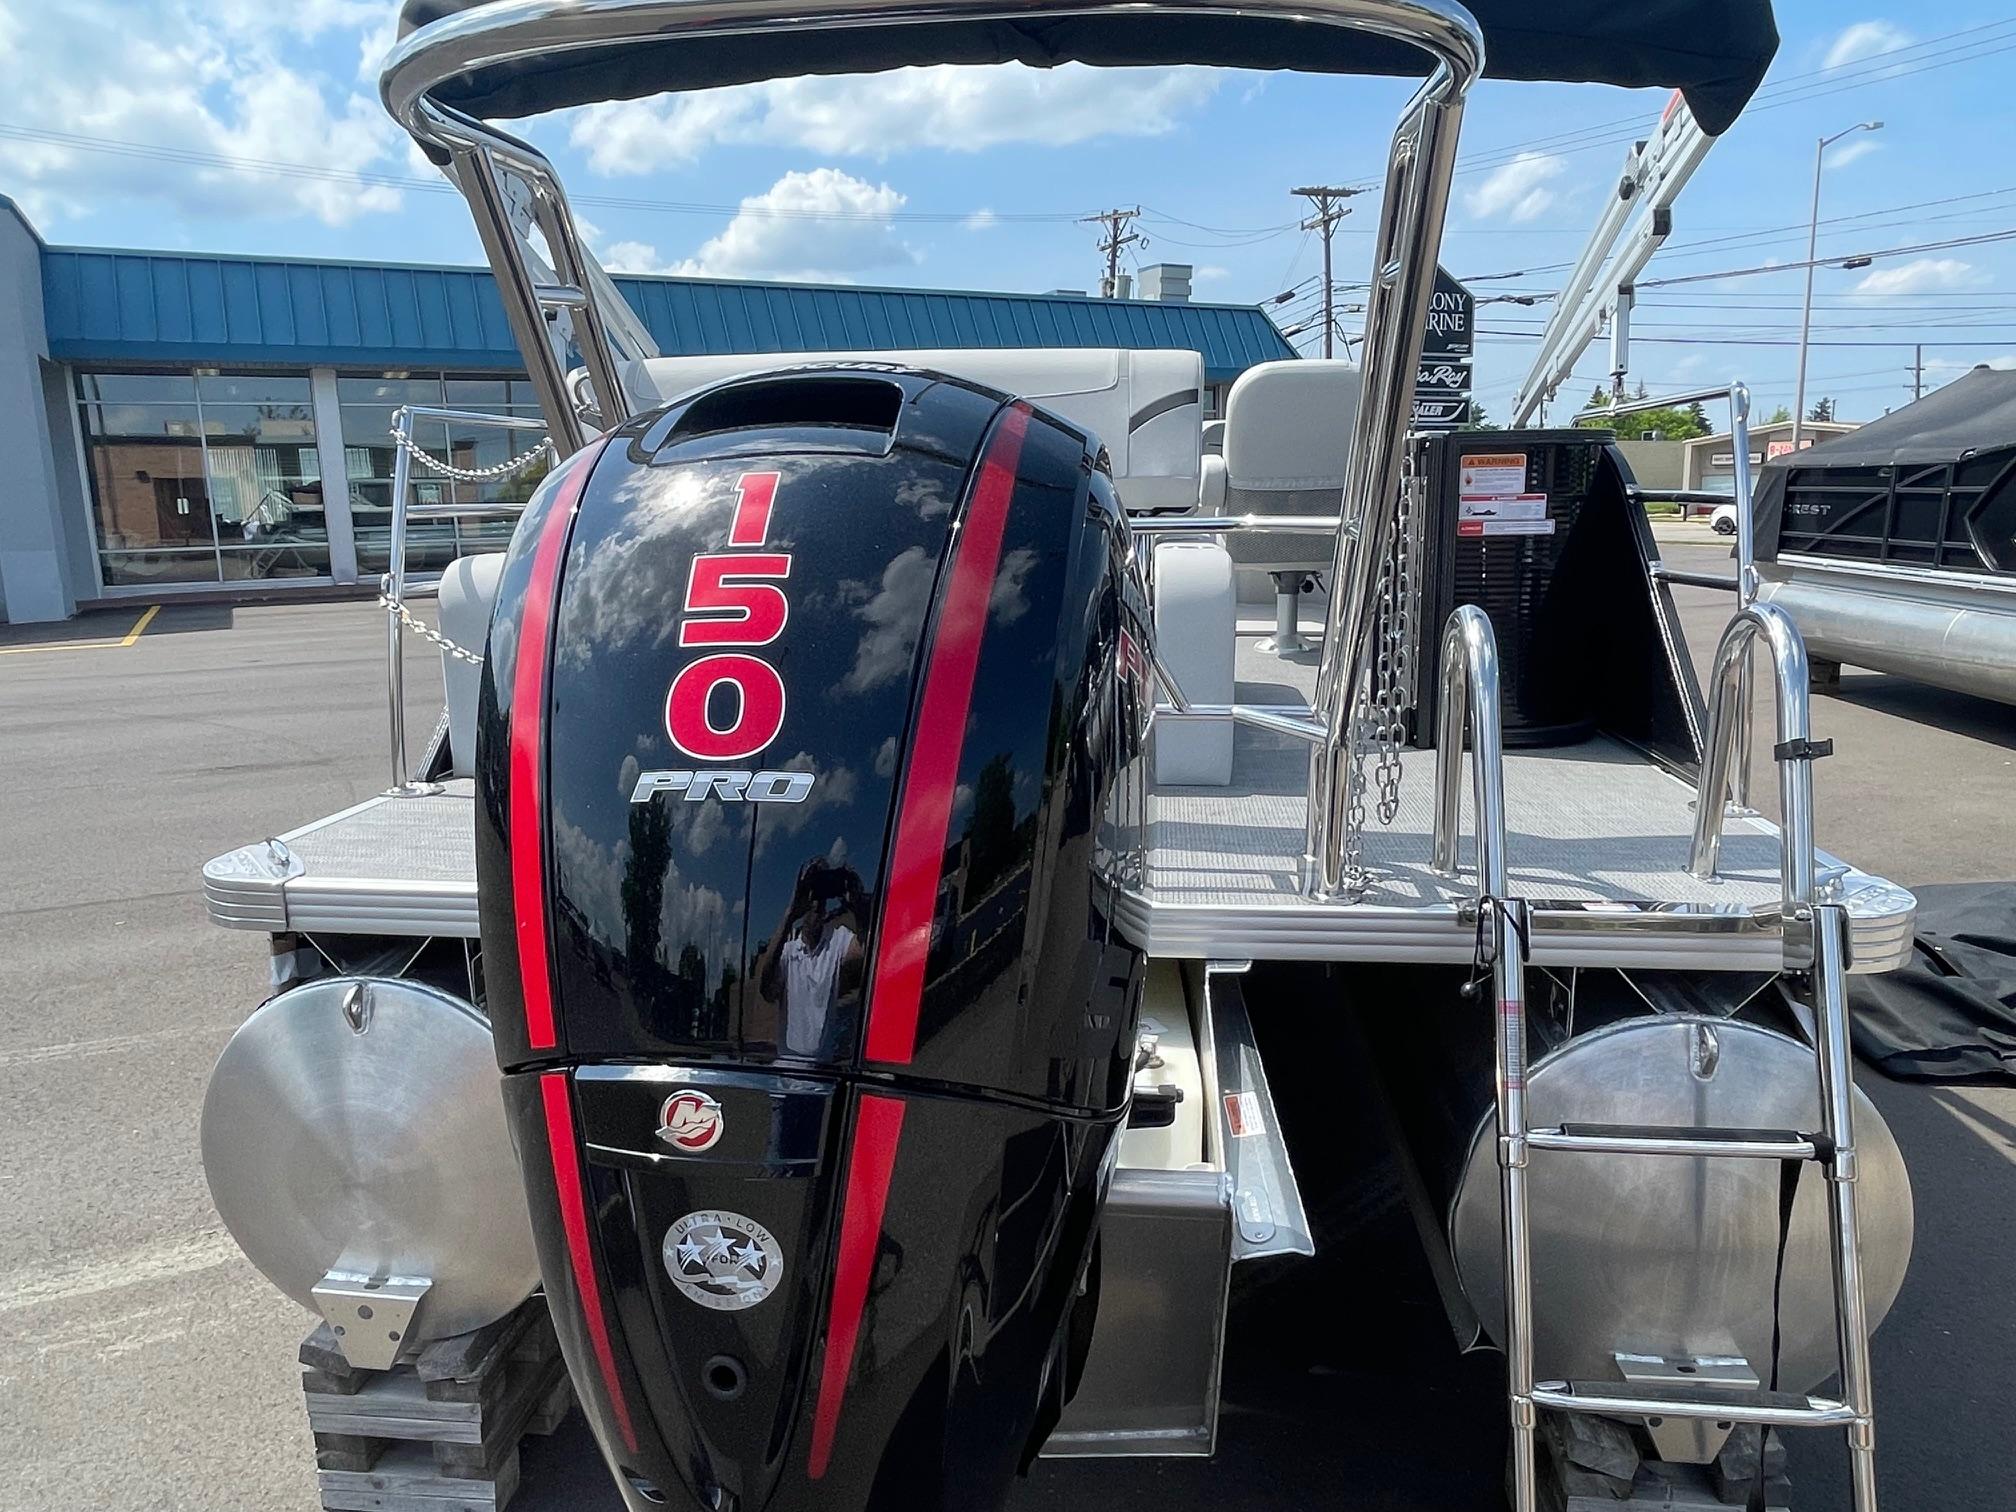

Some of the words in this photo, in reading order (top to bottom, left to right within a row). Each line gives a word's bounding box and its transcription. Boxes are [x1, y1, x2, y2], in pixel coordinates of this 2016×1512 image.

[1425, 312, 1465, 337] RINE
[1416, 405, 1444, 416] ALER
[1785, 503, 1831, 515] REST
[630, 770, 815, 803] PRO
[675, 1213, 722, 1235] ULTRA
[736, 1218, 770, 1243] LOW
